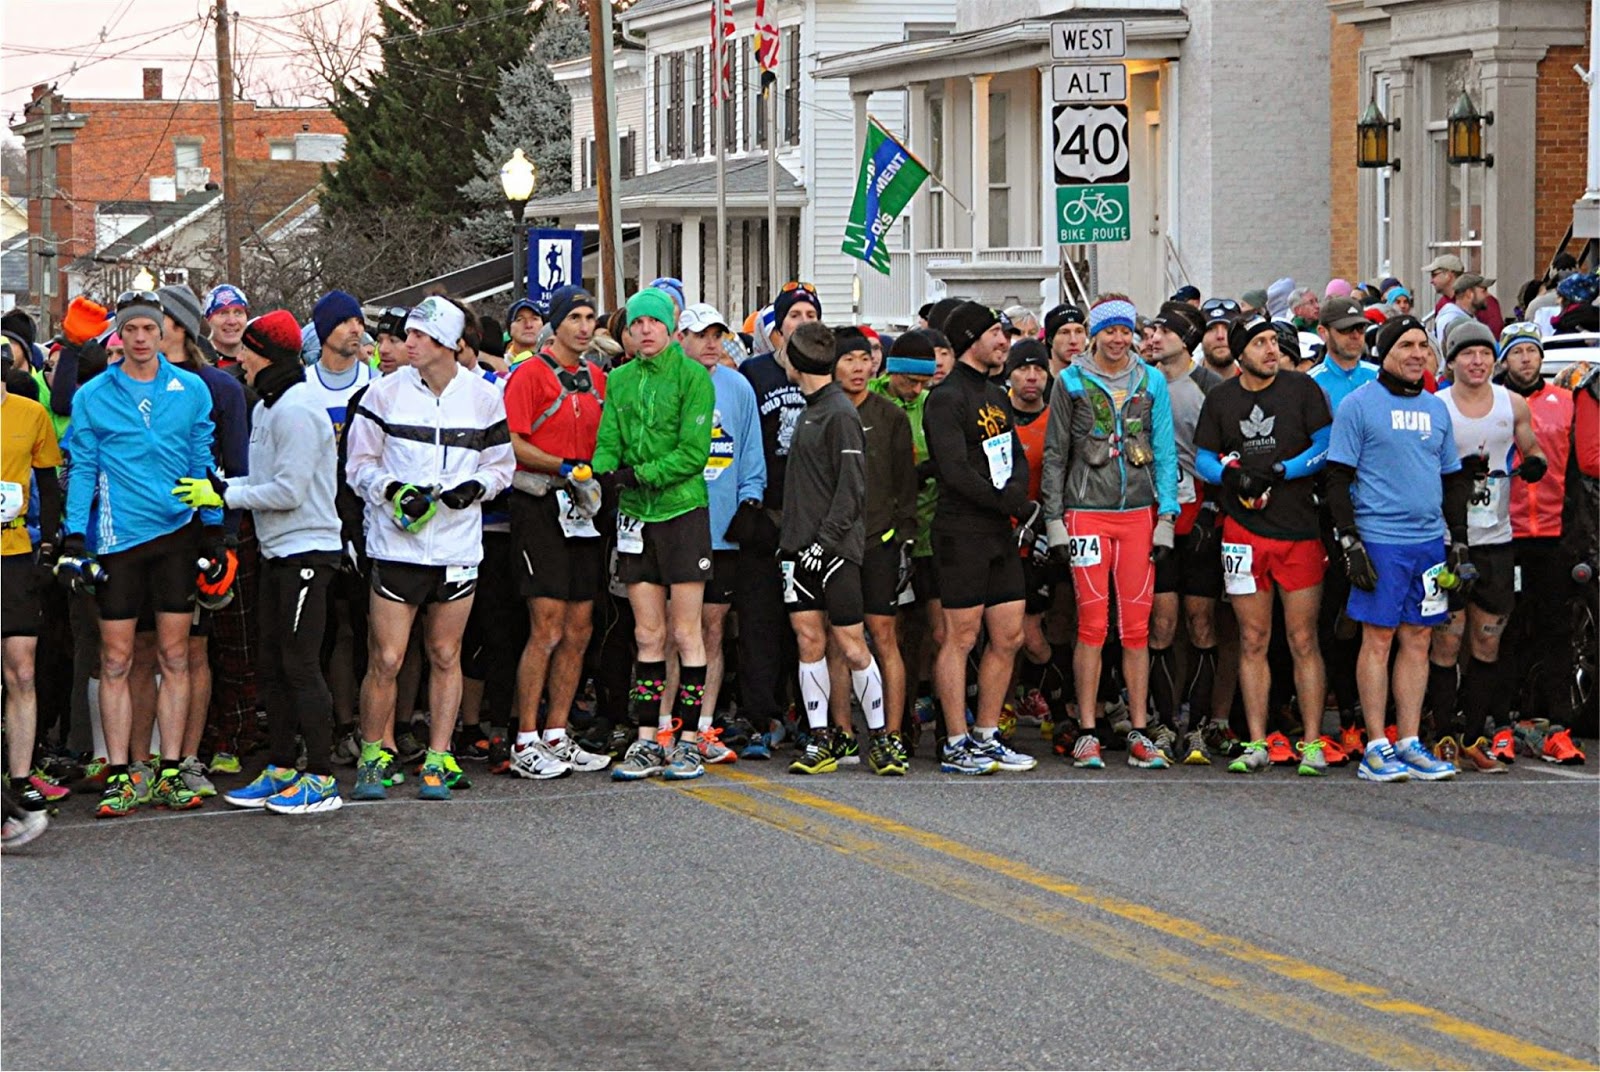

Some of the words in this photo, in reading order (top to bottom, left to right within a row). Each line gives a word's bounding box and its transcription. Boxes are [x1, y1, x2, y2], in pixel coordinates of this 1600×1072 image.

[1062, 28, 1113, 50] WEST
[1068, 72, 1111, 94] ALT
[1061, 123, 1120, 165] 40
[1061, 228, 1086, 241] BIKE
[1092, 227, 1127, 241] ROUTE
[1070, 537, 1100, 557] 874
